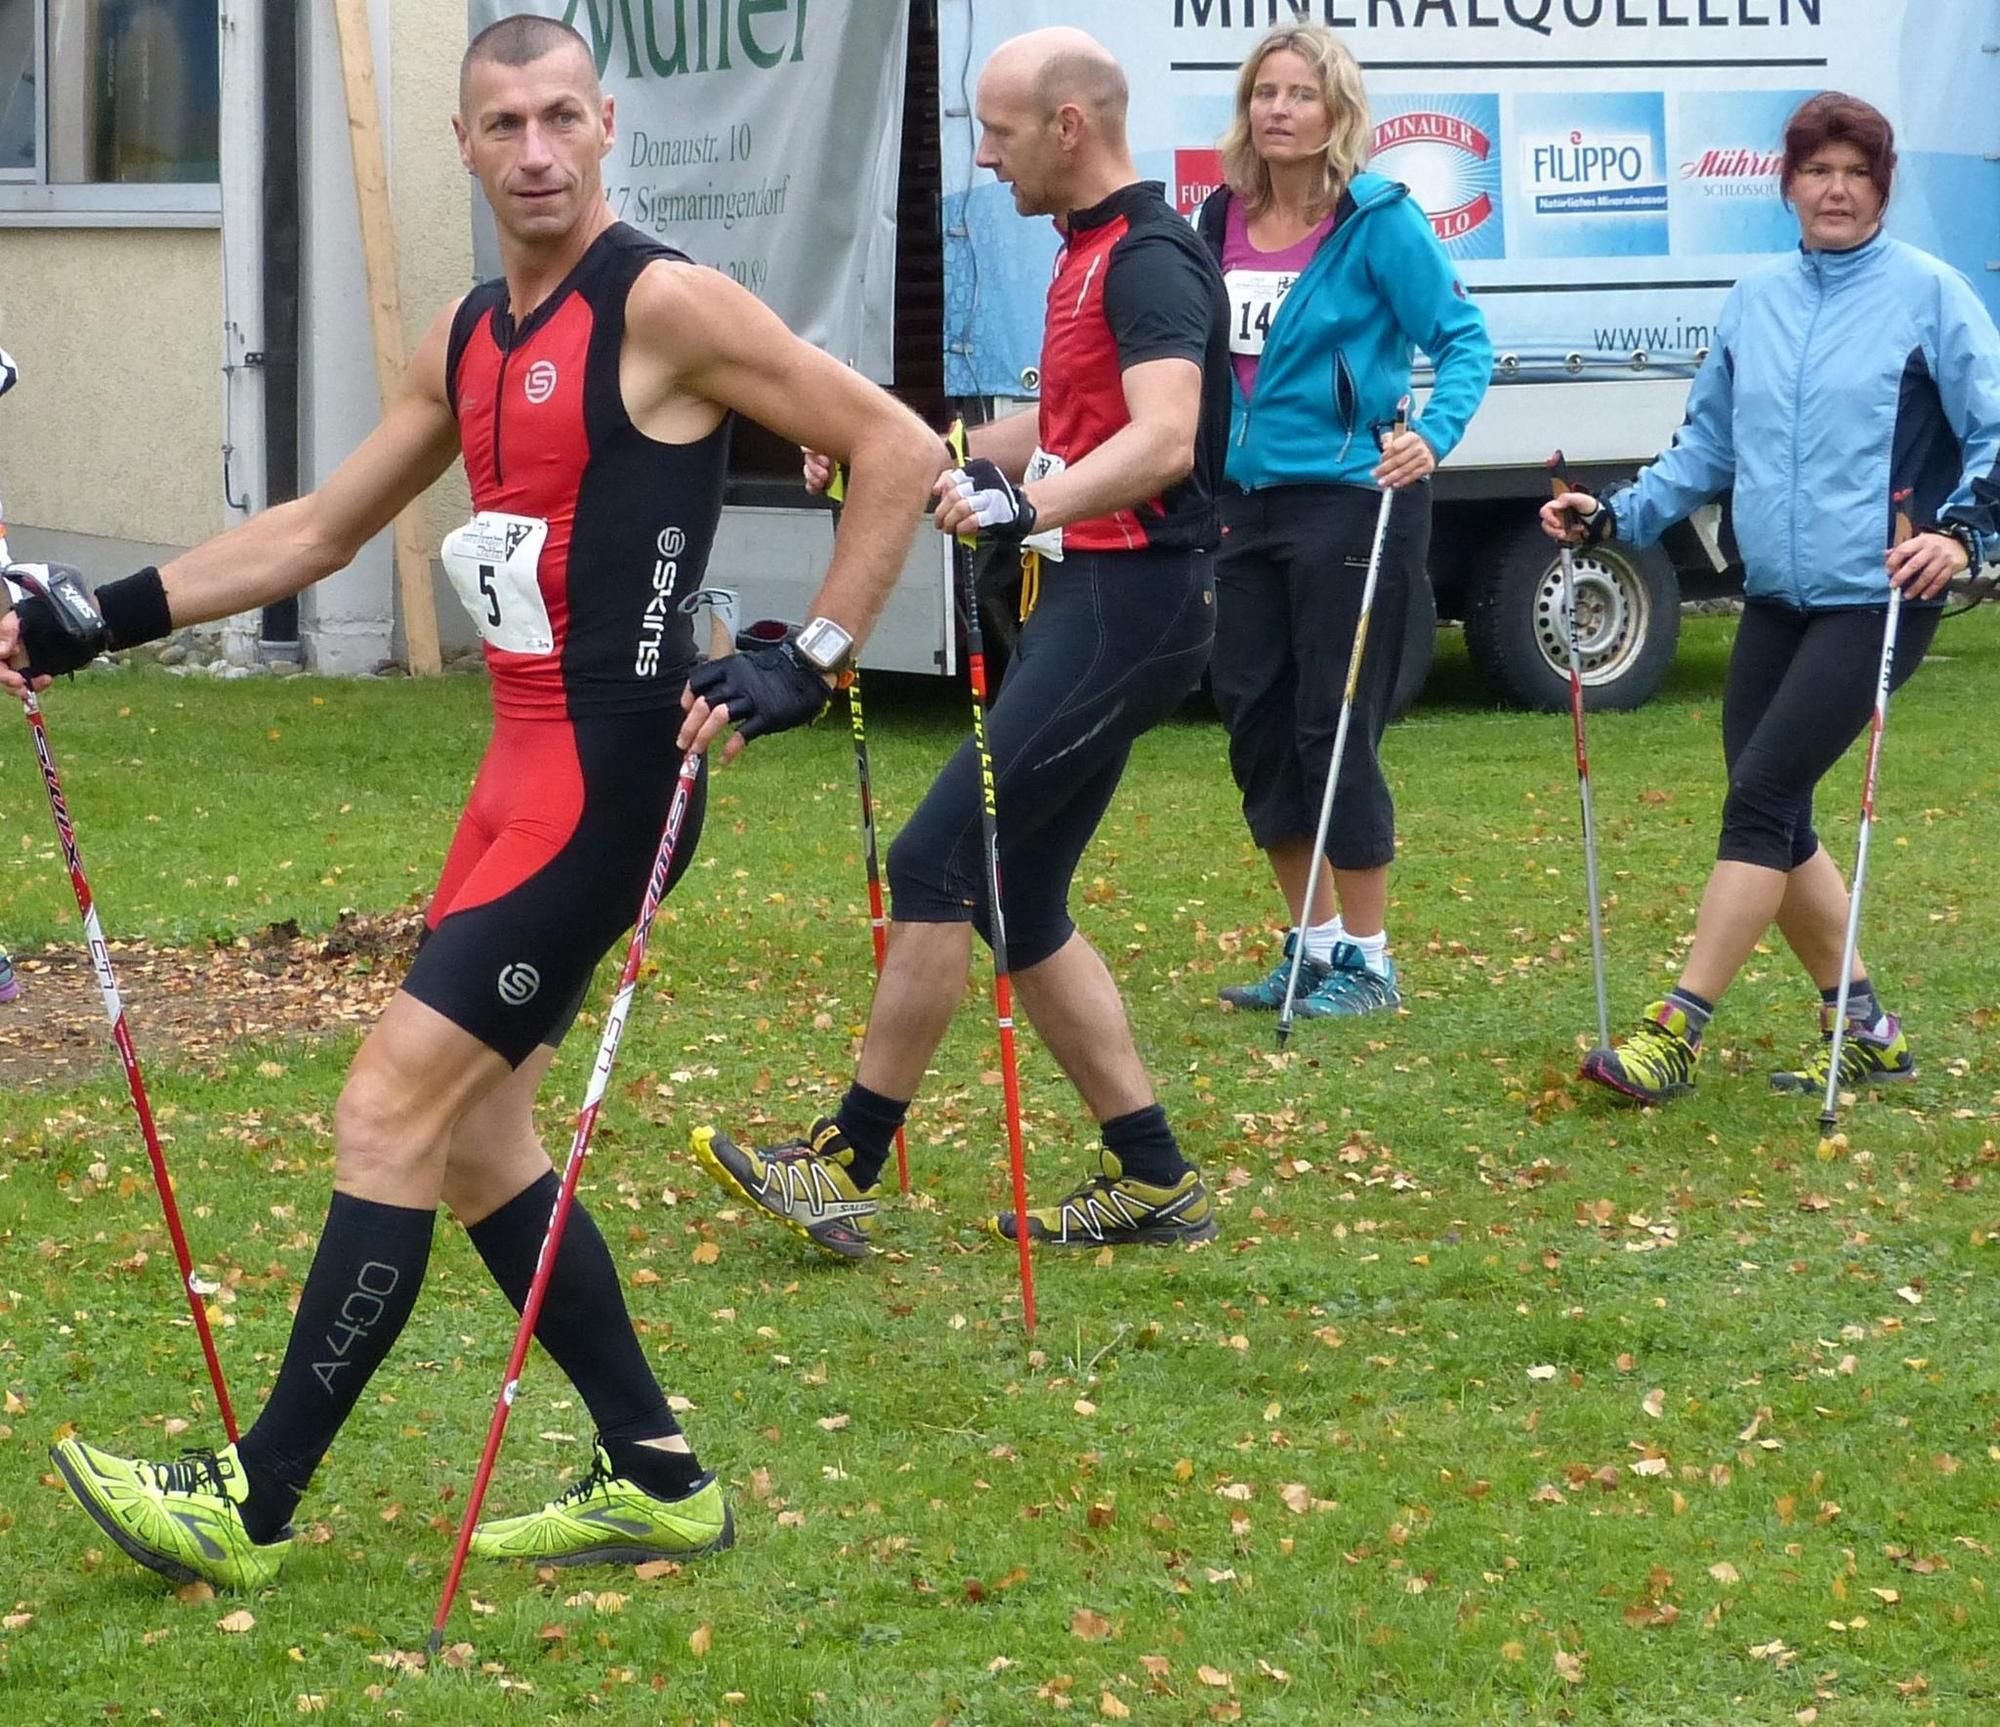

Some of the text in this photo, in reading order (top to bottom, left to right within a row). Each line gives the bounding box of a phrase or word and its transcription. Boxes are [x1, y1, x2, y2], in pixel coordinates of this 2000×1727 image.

[630, 123, 752, 168] Donaustr. 10
[1375, 116, 1473, 148] IMNAUER
[635, 174, 791, 232] Sigmaringendorf
[1703, 183, 1780, 197] SCHLOSSQU
[479, 565, 501, 627] 5
[849, 686, 865, 741] LEKI
[981, 753, 997, 816] LEKI
[312, 1261, 399, 1395] A400
